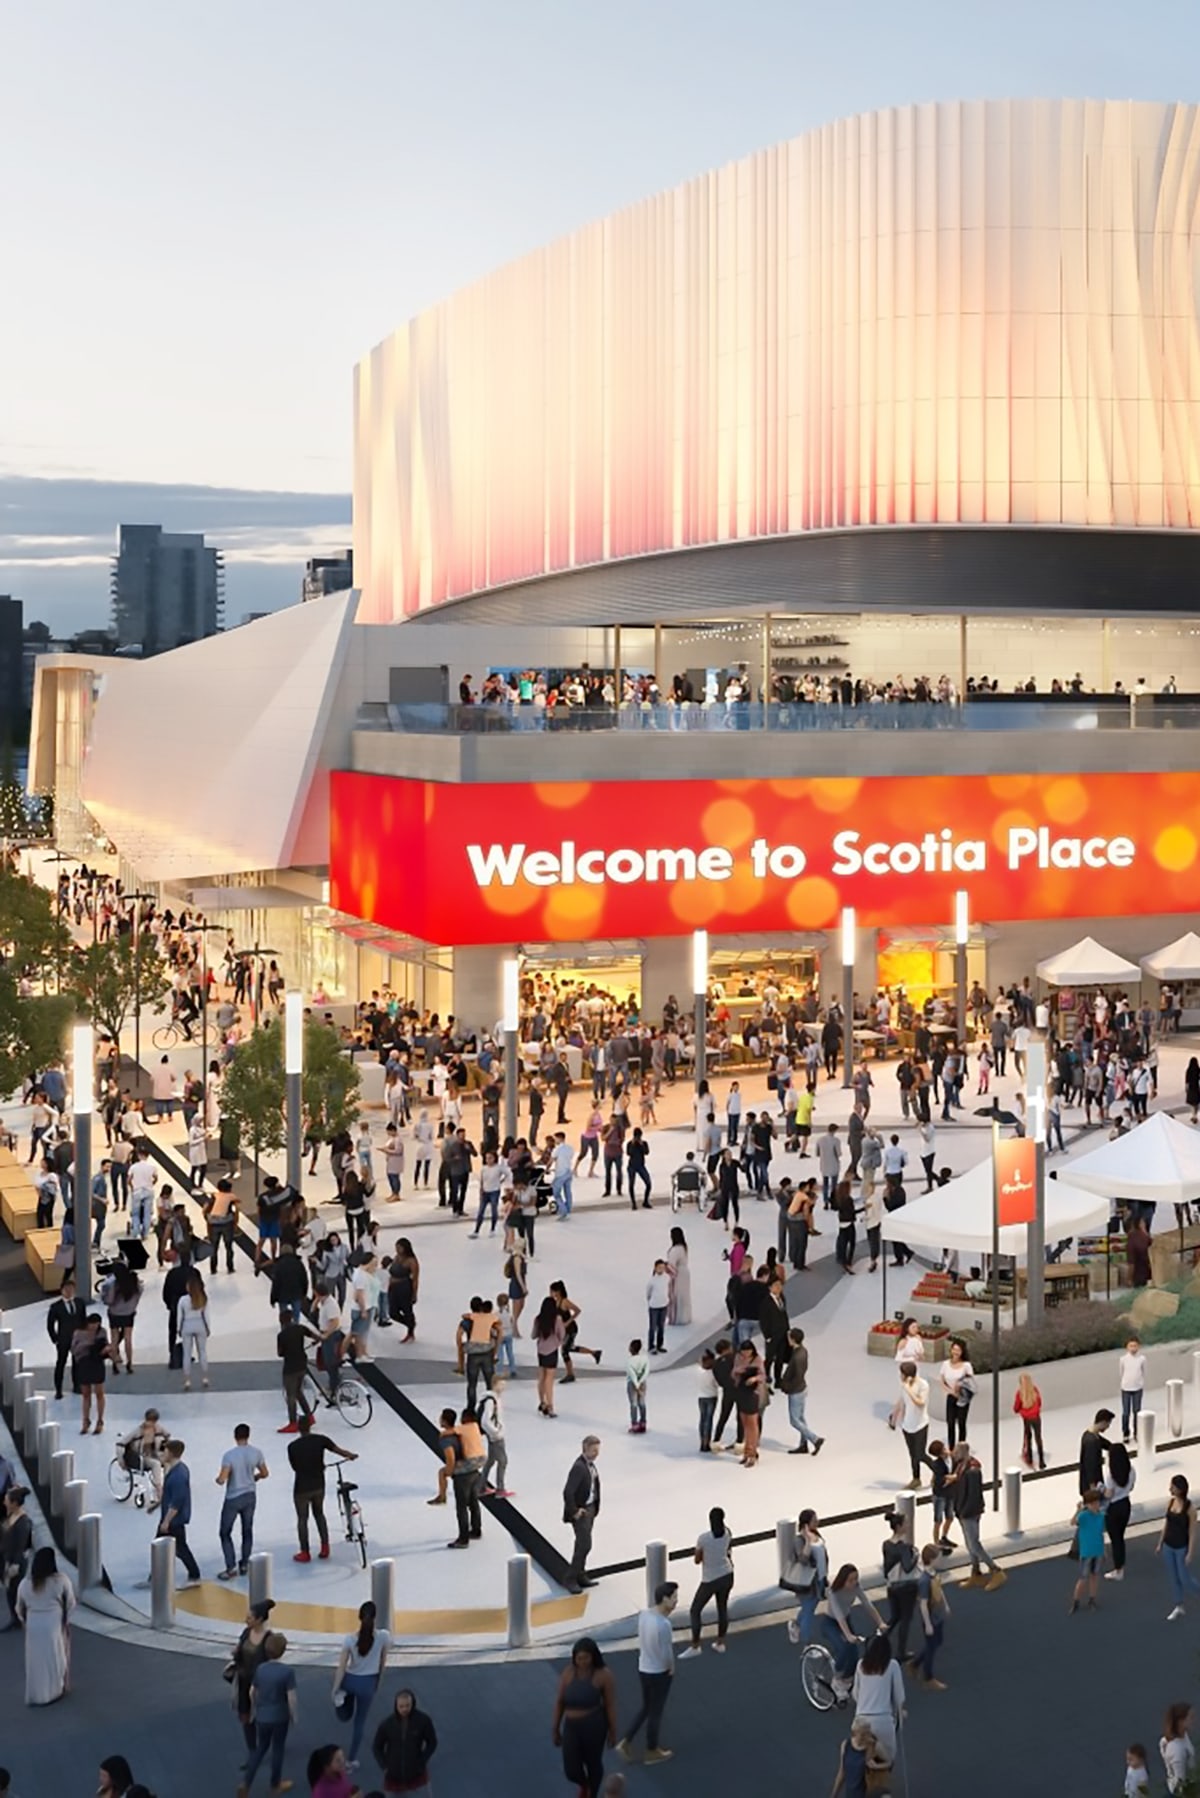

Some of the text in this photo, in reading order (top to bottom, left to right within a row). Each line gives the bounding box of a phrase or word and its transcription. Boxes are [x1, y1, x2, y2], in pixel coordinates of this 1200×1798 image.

[465, 826, 1136, 888] Welcome to Scotia Place
